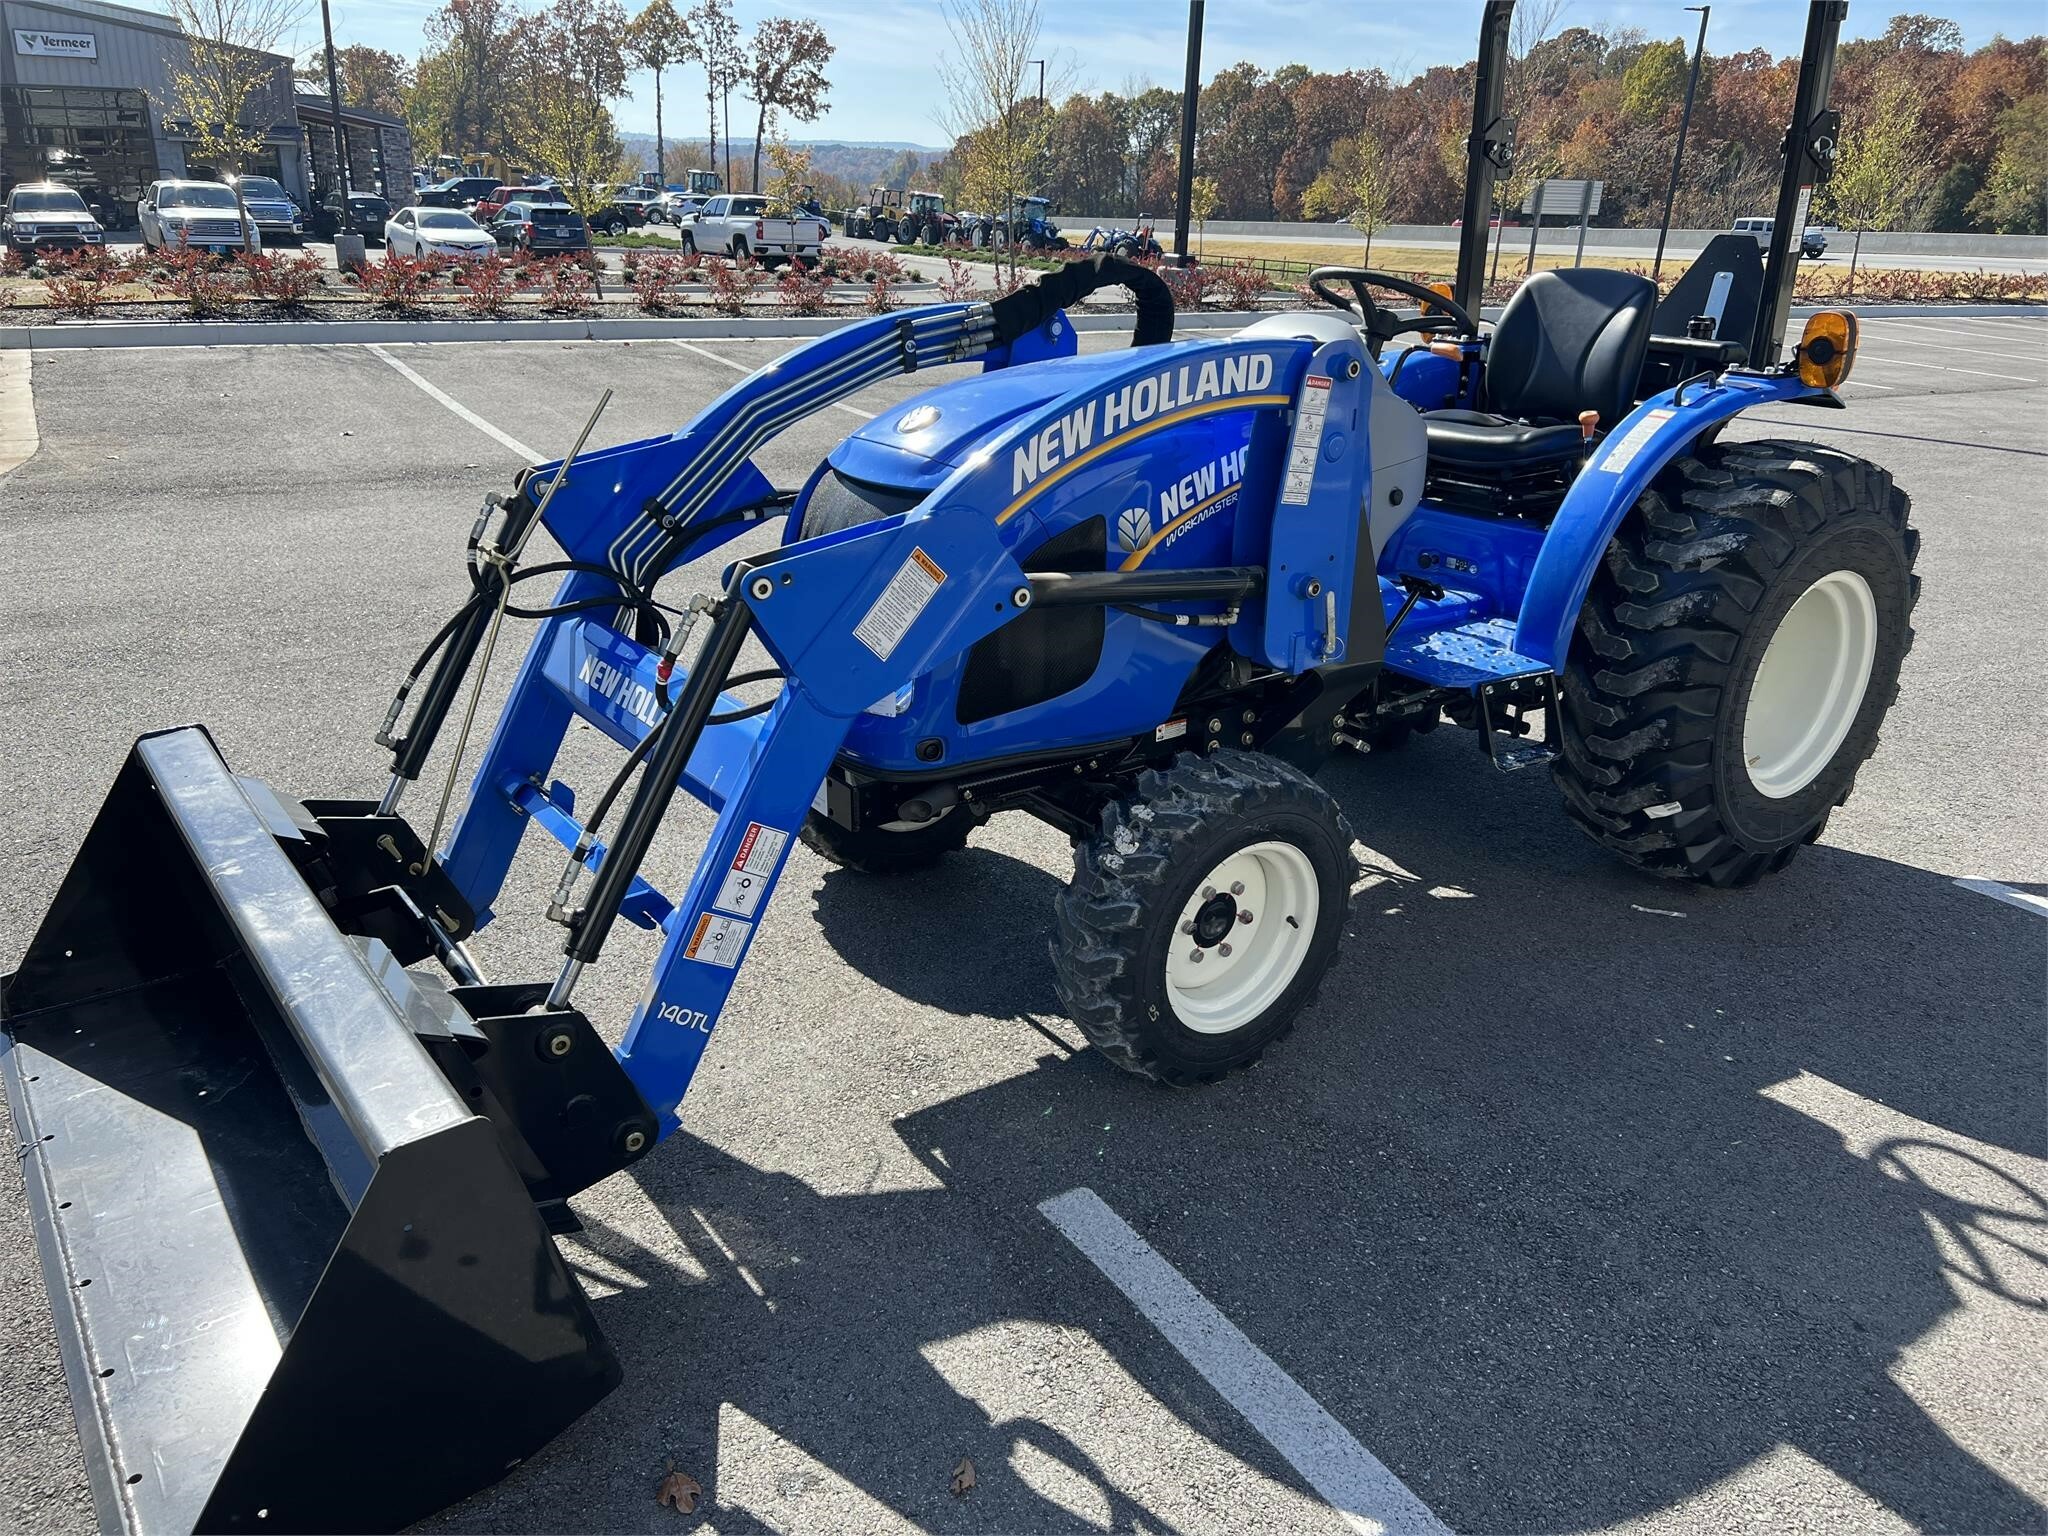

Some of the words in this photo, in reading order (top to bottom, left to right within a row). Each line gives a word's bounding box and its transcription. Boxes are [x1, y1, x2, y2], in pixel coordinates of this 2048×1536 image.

[40, 35, 91, 49] Vermeer
[1012, 400, 1097, 496] NEW
[1103, 354, 1273, 437] HOLLAND
[1160, 461, 1216, 525] NEW
[1166, 493, 1238, 548] WORKMASTER
[578, 653, 622, 699] NEW
[616, 676, 668, 728] HOLL
[741, 827, 758, 858] DANGER
[693, 918, 709, 946] WARNING
[656, 1001, 710, 1034] 140TL
